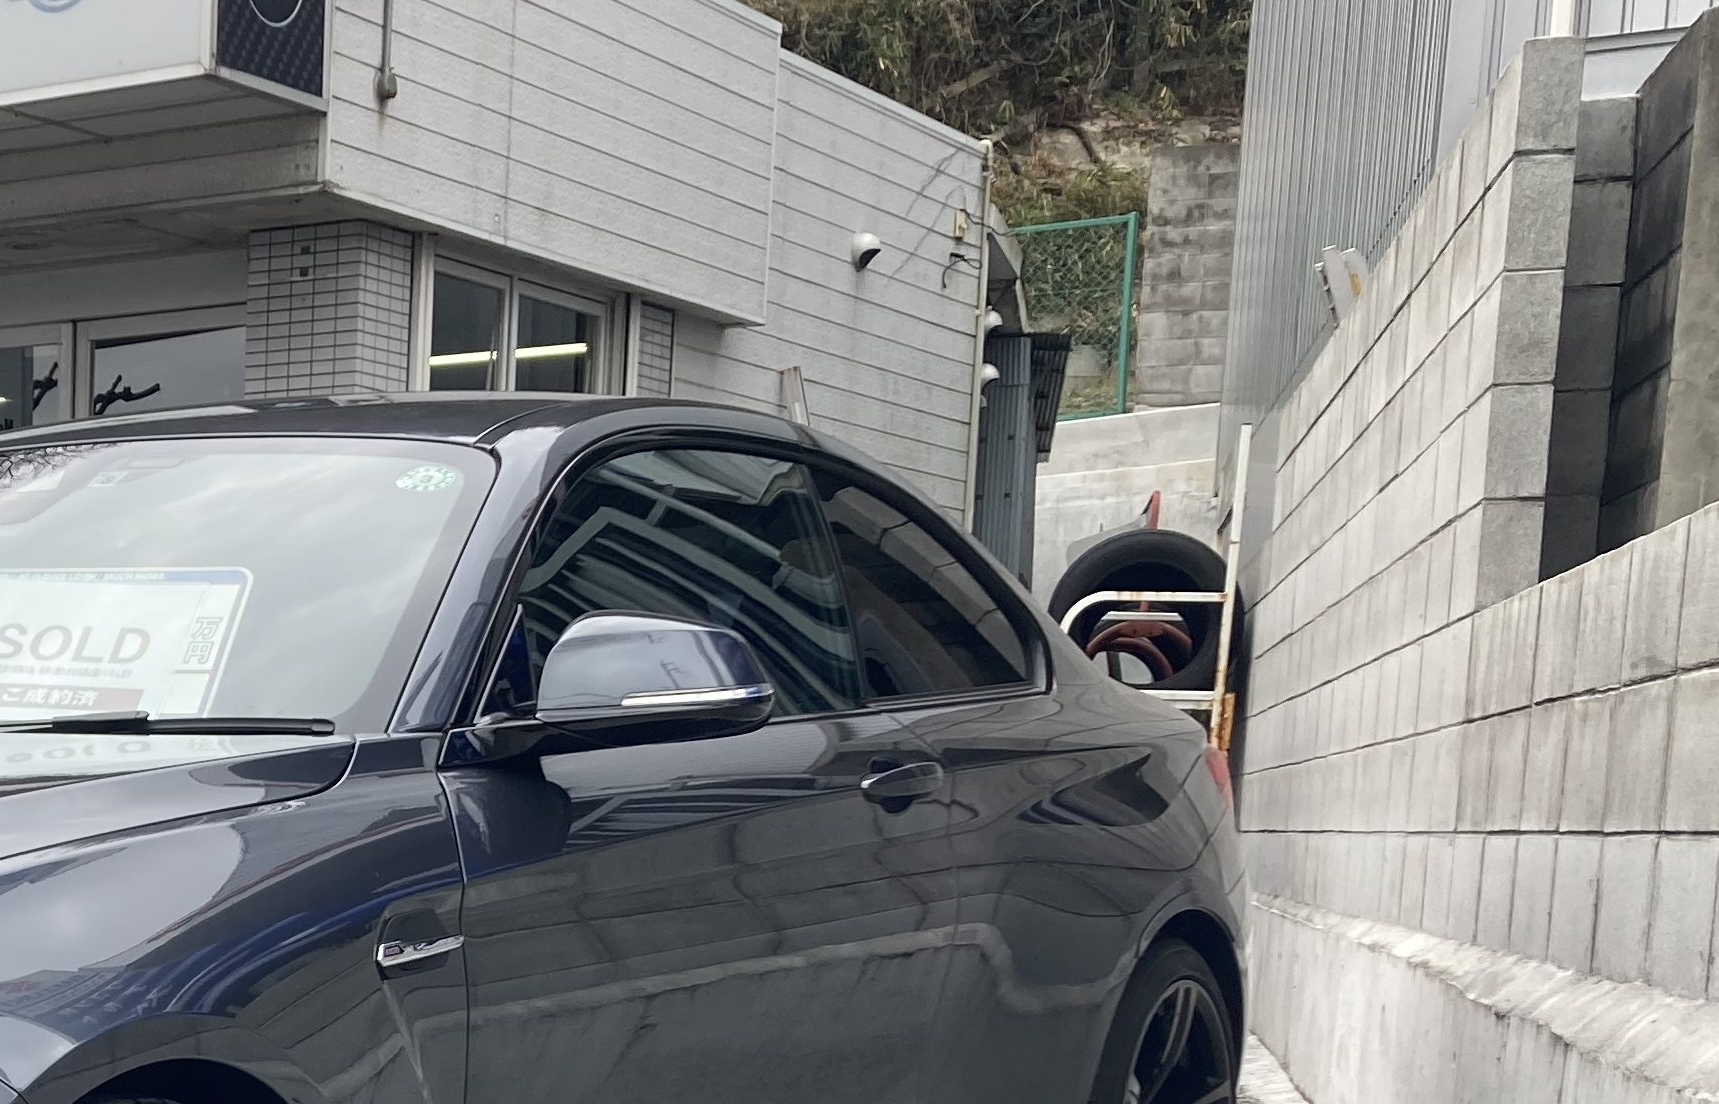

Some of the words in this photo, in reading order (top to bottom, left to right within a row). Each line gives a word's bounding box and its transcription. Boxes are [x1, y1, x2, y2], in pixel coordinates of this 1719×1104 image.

[183, 616, 223, 665] 万円
[0, 687, 100, 708] ご成約済
